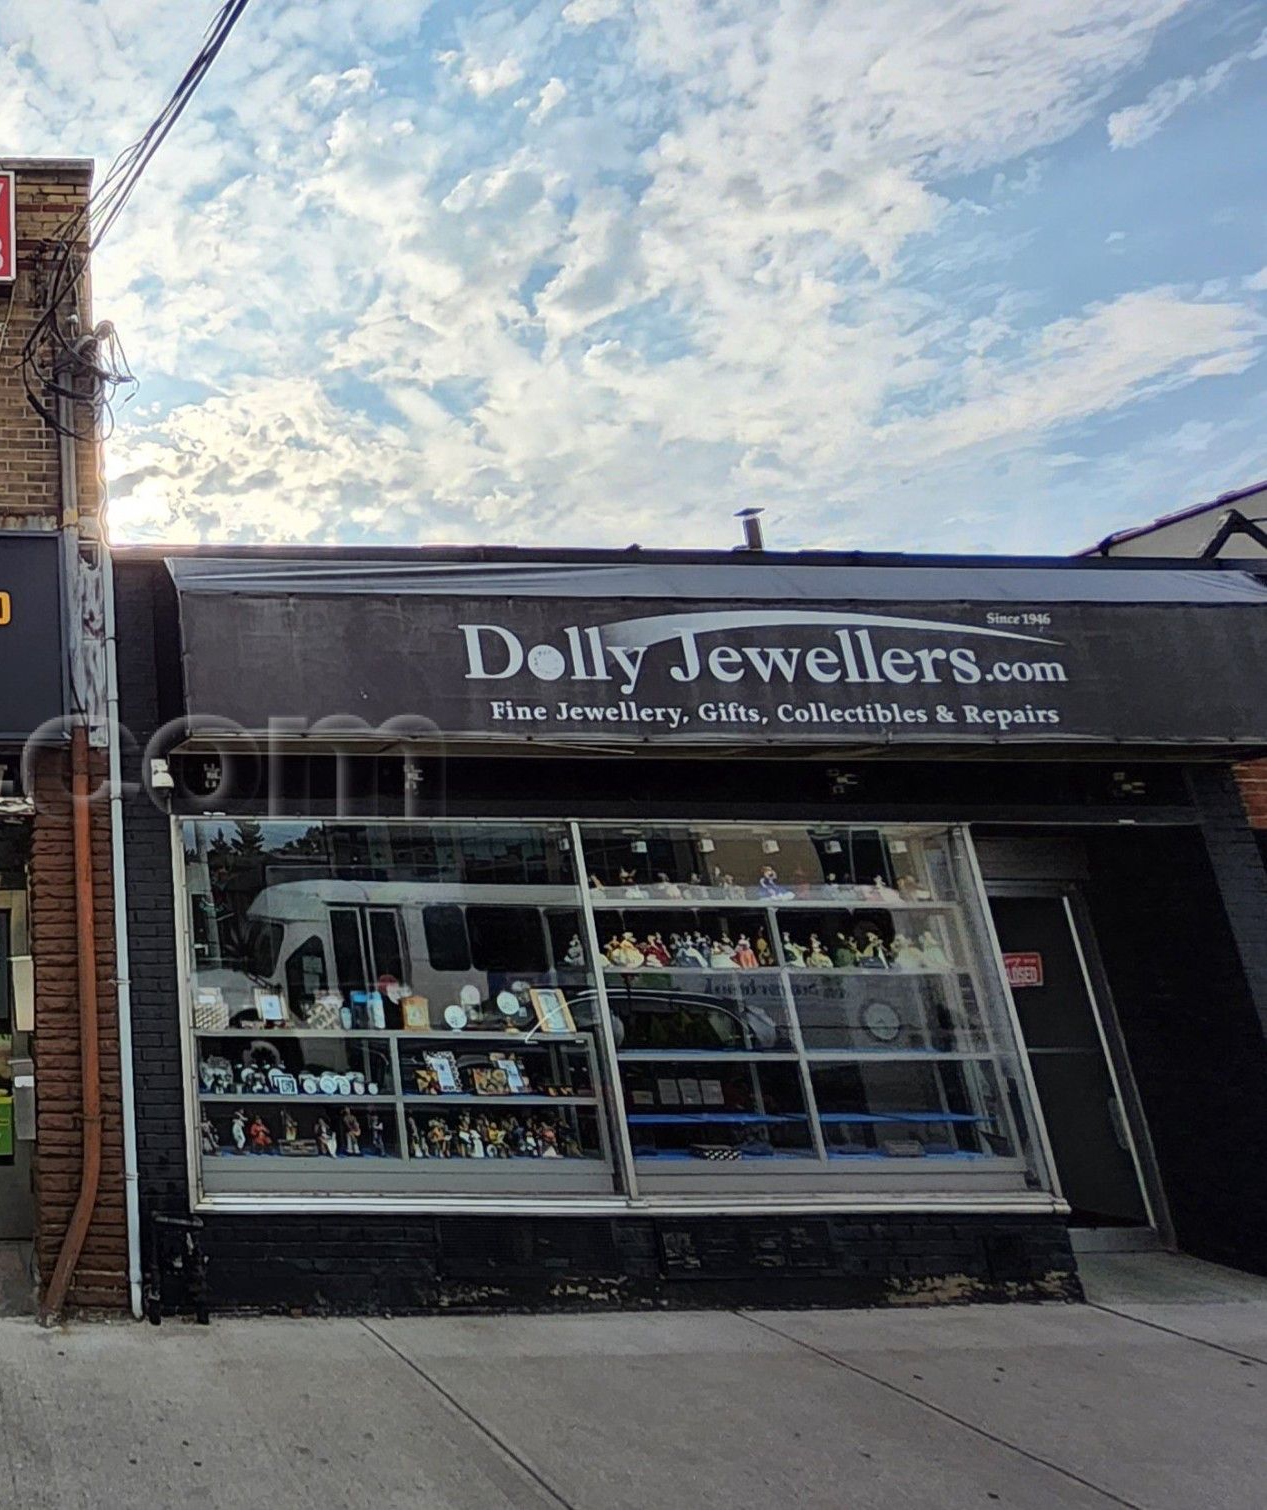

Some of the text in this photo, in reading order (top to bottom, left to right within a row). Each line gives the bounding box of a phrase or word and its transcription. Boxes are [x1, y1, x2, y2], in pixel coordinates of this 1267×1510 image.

[986, 612, 1052, 626] Since 1946
[458, 623, 649, 694] Dolly
[490, 700, 1060, 730] Fine Jewellery, Gifts, Collectibles & Repairs
[1006, 966, 1038, 983] LOSED
